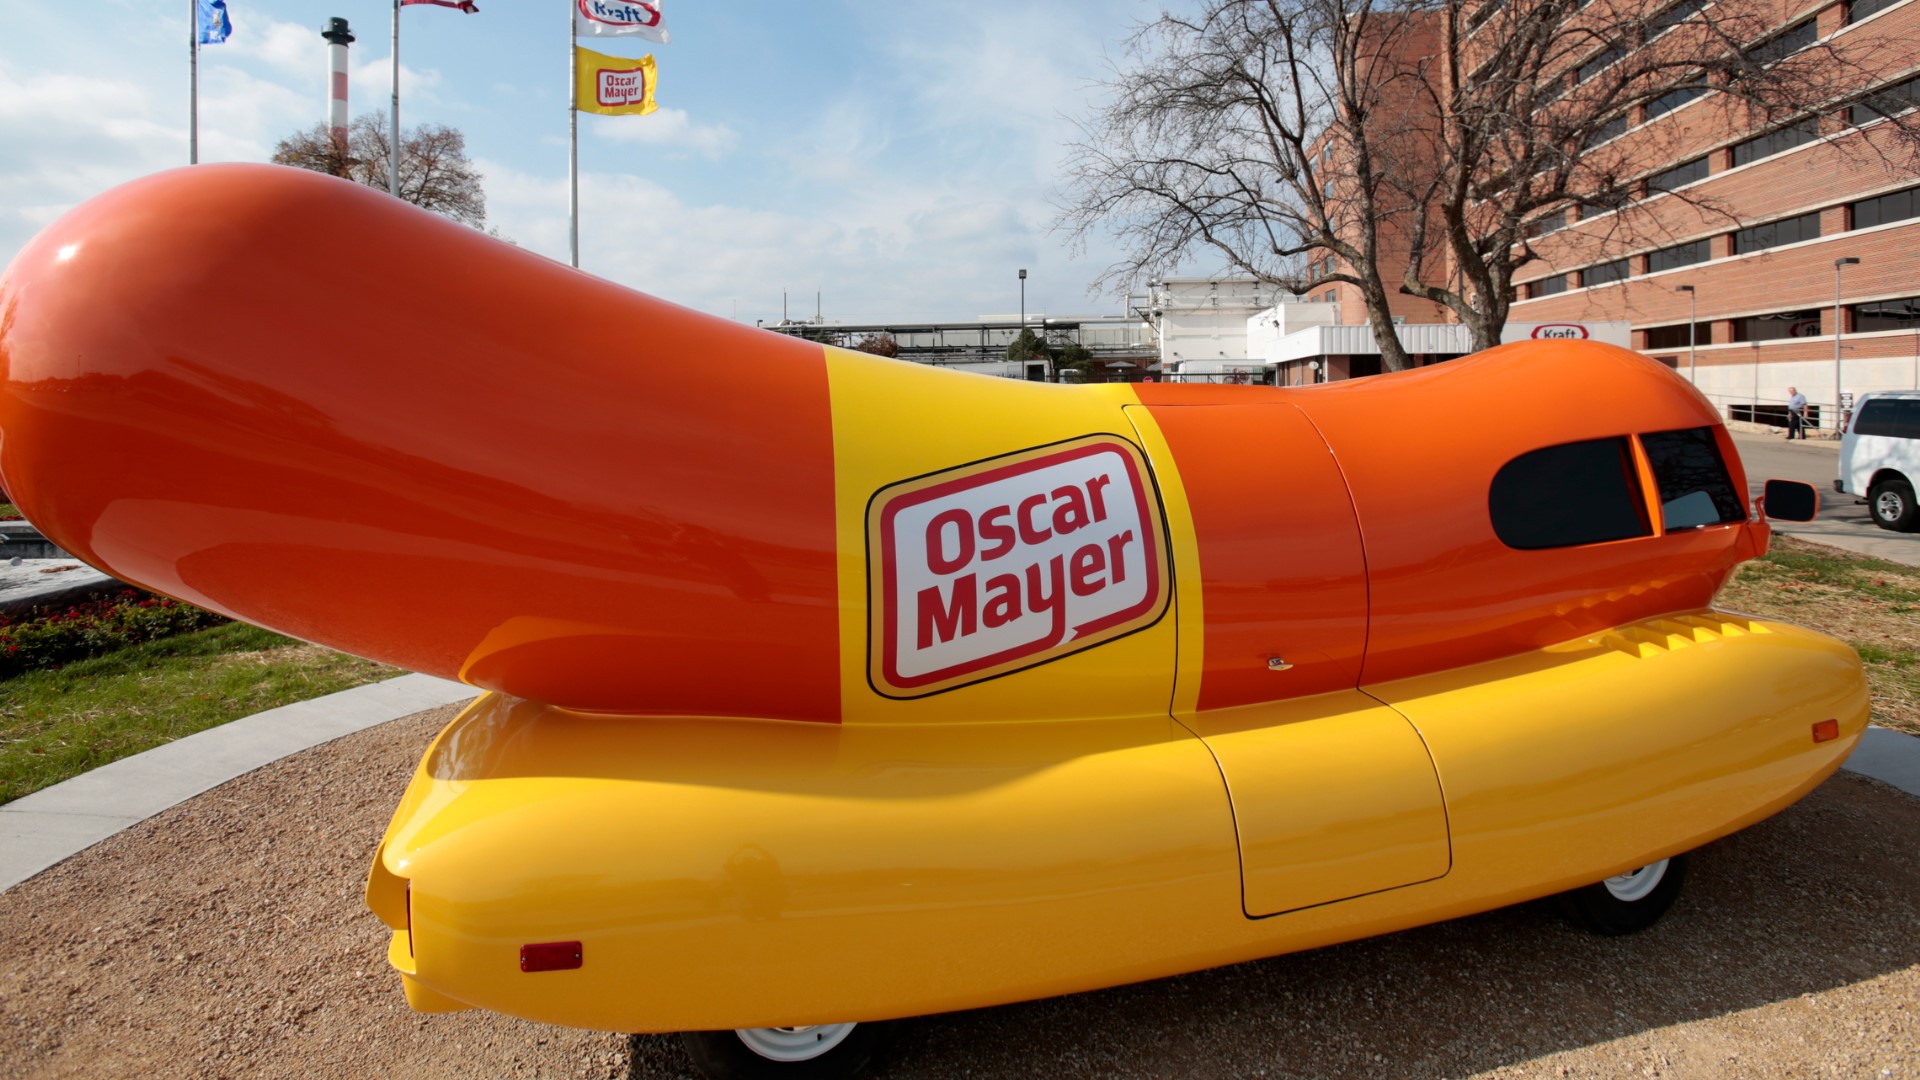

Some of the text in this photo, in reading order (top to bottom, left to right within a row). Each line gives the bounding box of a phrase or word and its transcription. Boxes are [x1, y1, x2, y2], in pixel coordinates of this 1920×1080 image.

[594, 1, 643, 22] Kraft
[606, 75, 637, 86] Oscar
[605, 87, 639, 102] Mayer
[1544, 329, 1575, 338] Kraft
[925, 473, 1111, 575] Oscar
[917, 529, 1134, 650] Mayer
